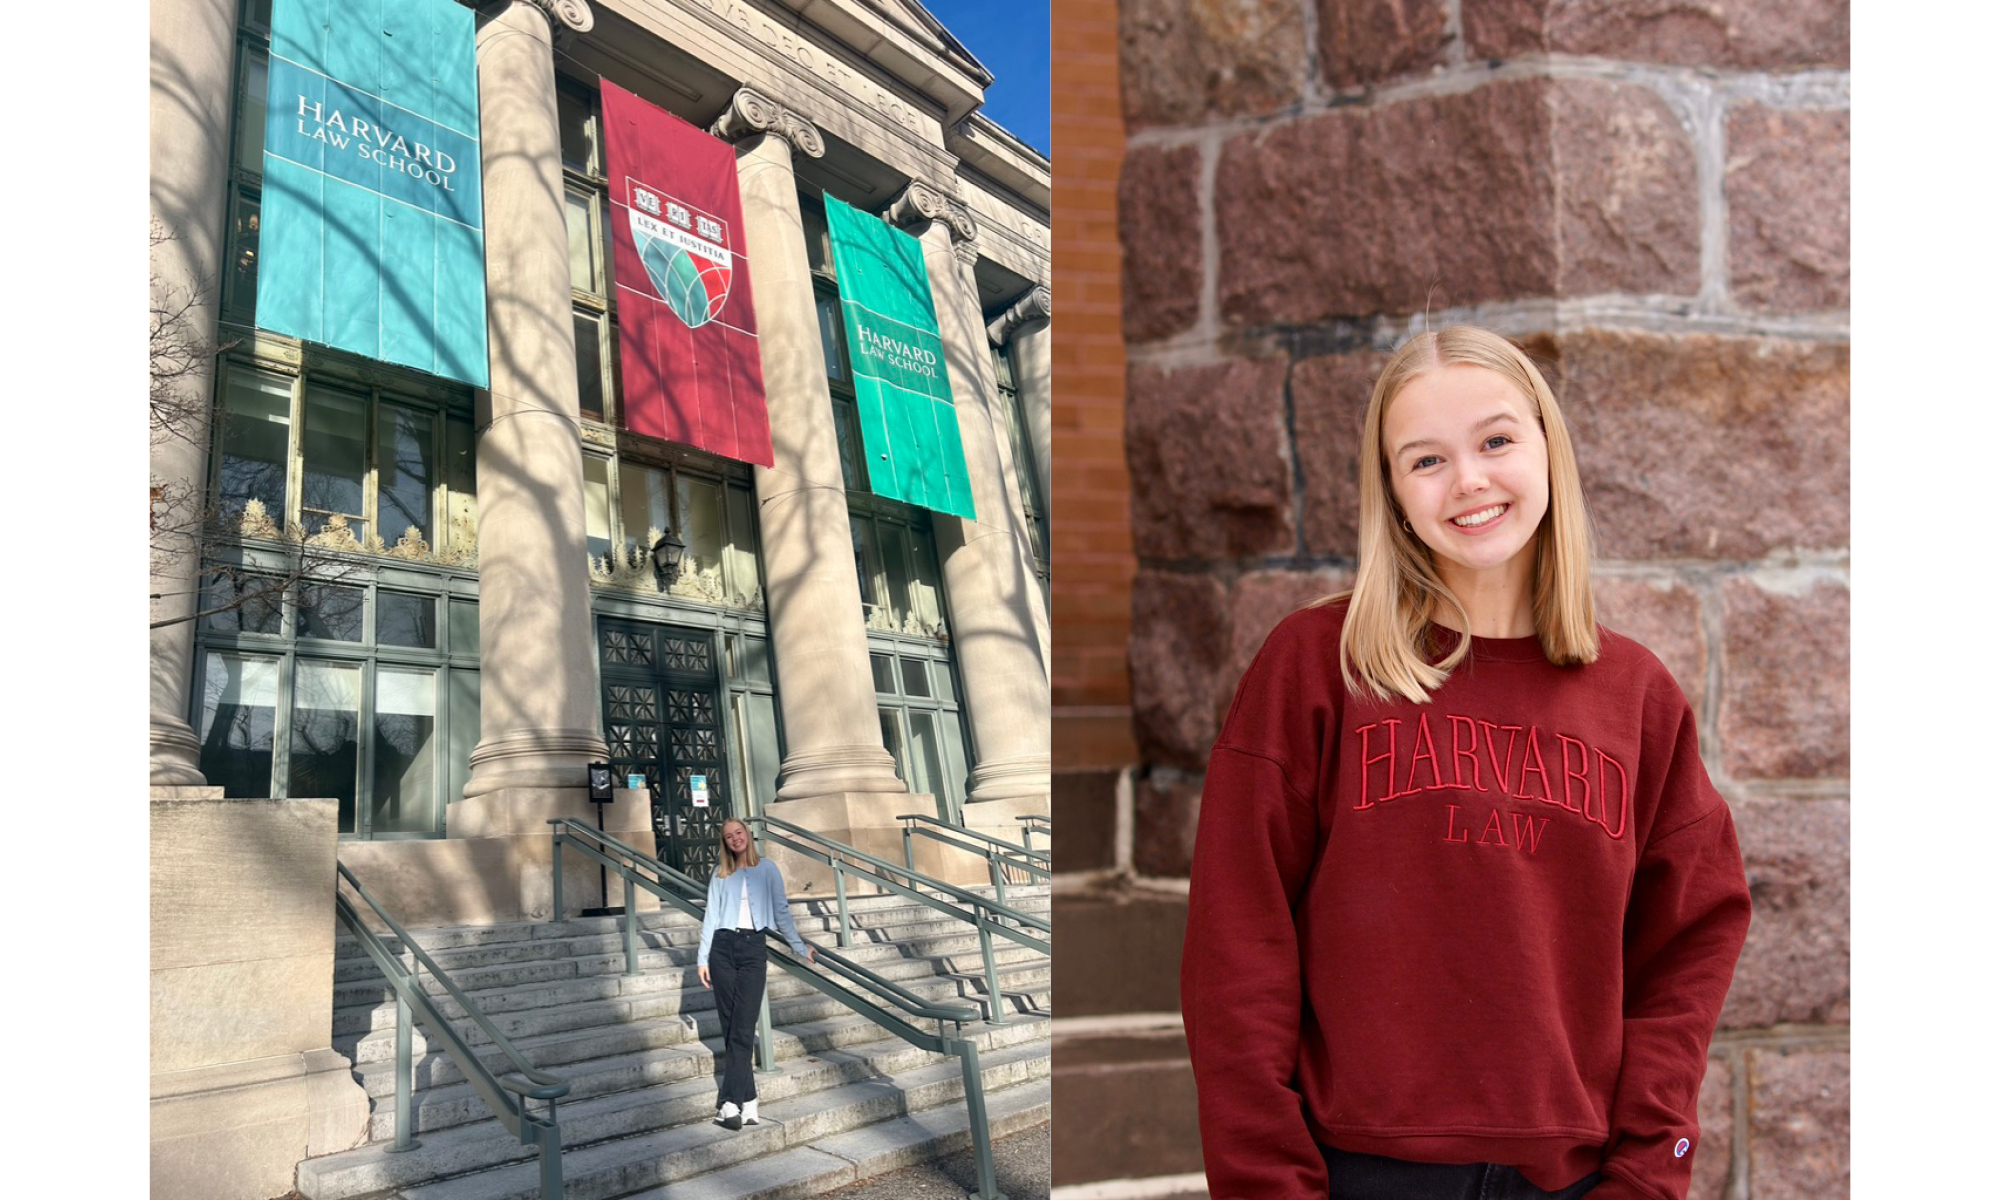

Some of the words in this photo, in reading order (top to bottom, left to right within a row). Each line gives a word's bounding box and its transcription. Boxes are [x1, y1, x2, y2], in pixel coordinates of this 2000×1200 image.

[762, 23, 815, 69] DEO
[826, 62, 851, 86] ET
[297, 94, 456, 174] HARVARD
[297, 117, 350, 150] LAW
[357, 143, 455, 192] SCHOOL
[637, 217, 658, 232] LEX
[662, 227, 674, 239] ET
[679, 235, 725, 260] IUSTITIA
[857, 323, 937, 366] HARVARD
[860, 342, 884, 361] LAW
[887, 353, 938, 379] SCHOOL
[1352, 711, 1629, 841] HARVARD
[1442, 804, 1551, 854] LAW
